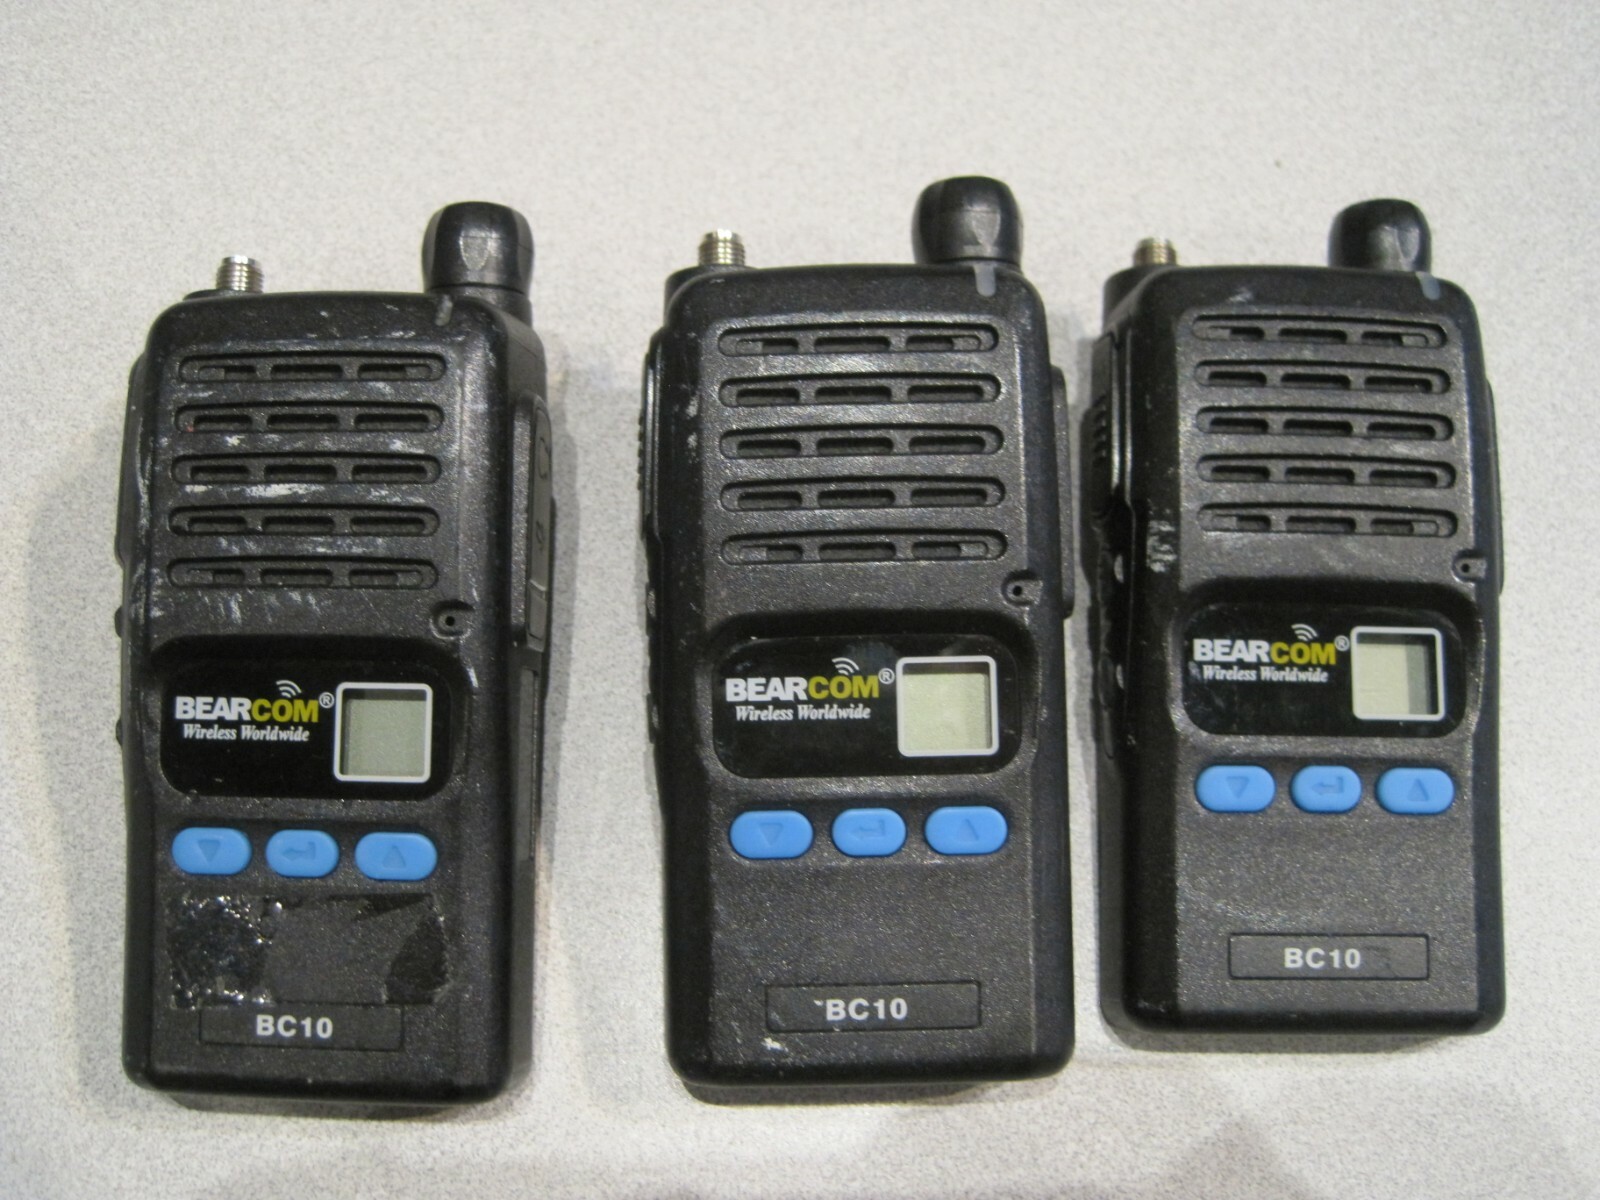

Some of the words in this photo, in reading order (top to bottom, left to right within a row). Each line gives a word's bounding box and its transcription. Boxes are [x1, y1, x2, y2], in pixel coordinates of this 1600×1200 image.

[1202, 664, 1257, 681] Wireless
[1260, 665, 1328, 683] Worldwide
[735, 704, 794, 721] Wireless
[798, 703, 871, 721] Worldwide
[183, 723, 237, 741] Wireless
[240, 725, 310, 742] Worldwide
[1283, 947, 1361, 968] BC10
[826, 998, 908, 1021] BC10
[256, 1014, 333, 1038] BC10
